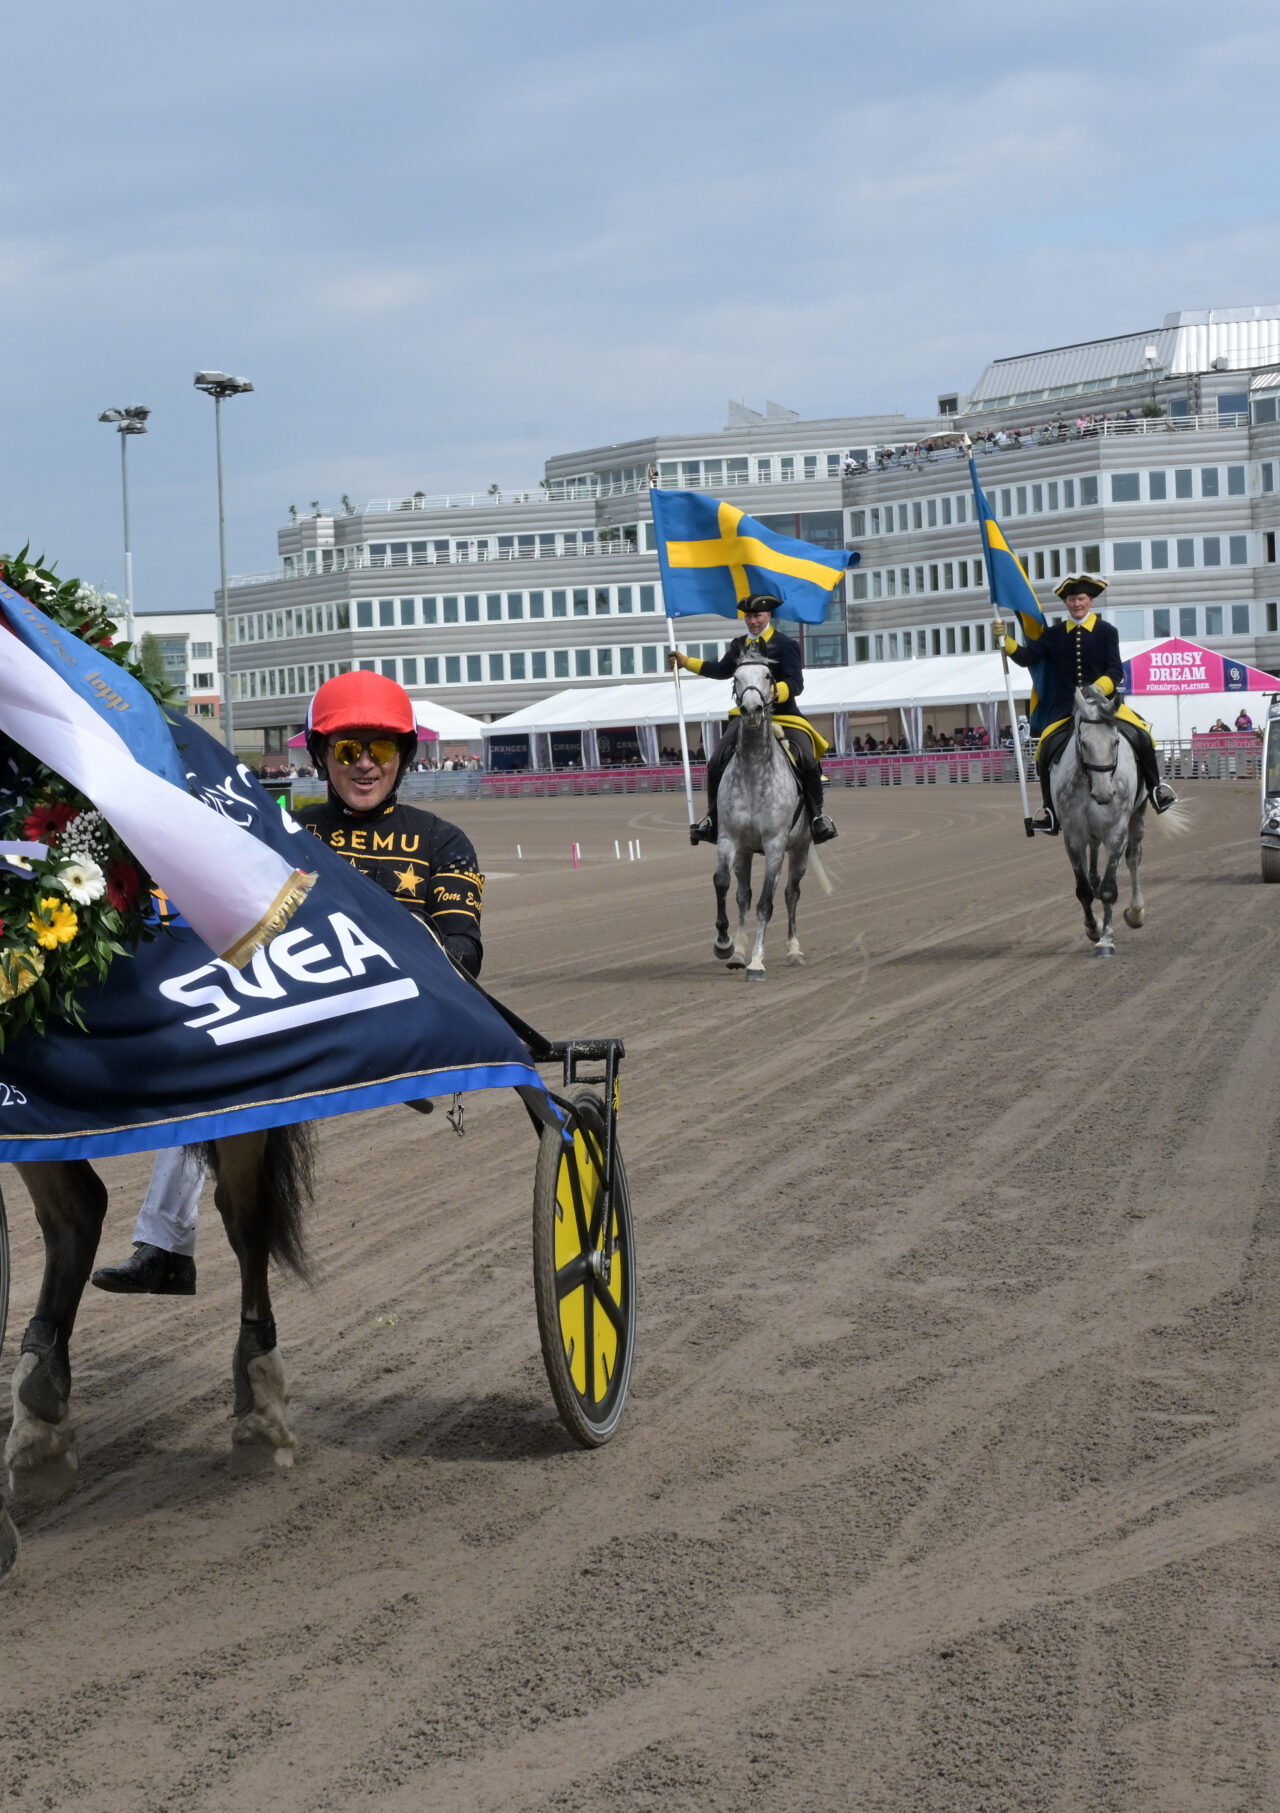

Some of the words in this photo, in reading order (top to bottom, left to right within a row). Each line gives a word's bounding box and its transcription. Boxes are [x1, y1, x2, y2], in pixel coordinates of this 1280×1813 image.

[1150, 652, 1203, 666] HORSY
[1149, 666, 1206, 681] DREAM
[330, 829, 419, 853] SEMU
[433, 886, 461, 903] Tom
[159, 912, 400, 1029] SVEA
